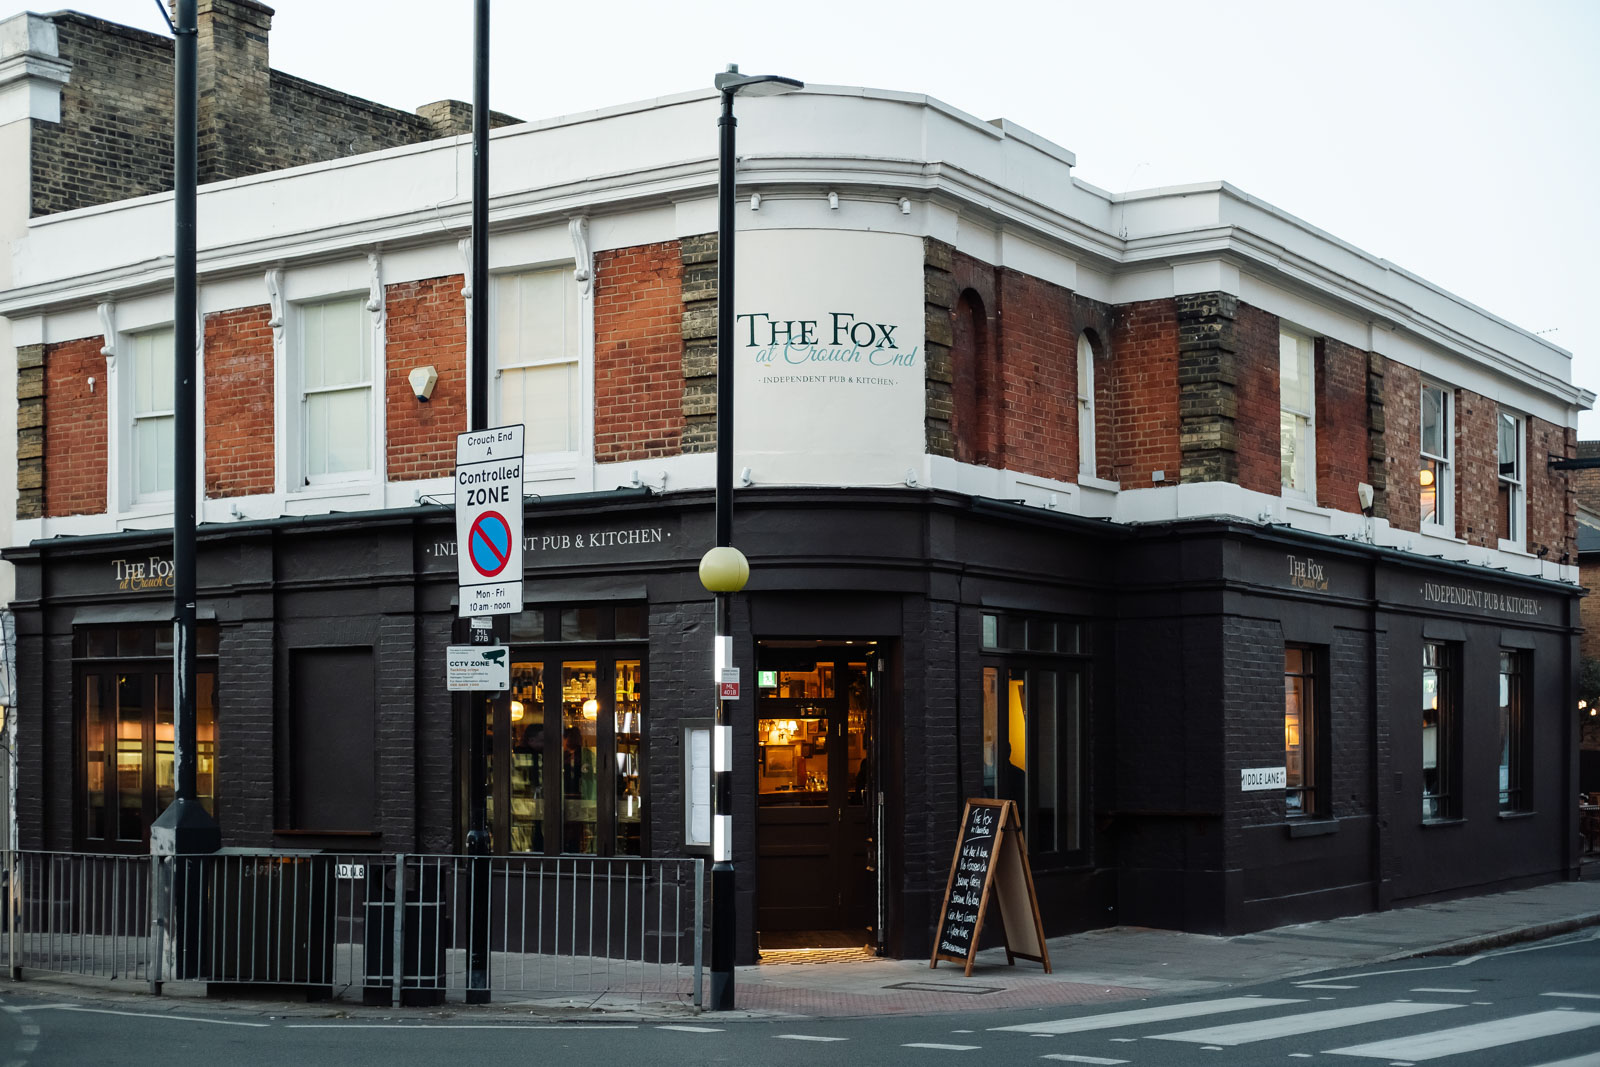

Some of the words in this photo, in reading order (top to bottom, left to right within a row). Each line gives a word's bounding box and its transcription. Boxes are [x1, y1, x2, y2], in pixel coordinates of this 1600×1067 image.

[755, 340, 778, 363] at
[783, 334, 862, 365] Crouch
[869, 337, 918, 367] End
[763, 375, 827, 384] INDEPENDENT
[829, 375, 846, 384] PUB
[848, 376, 854, 384] &
[856, 376, 894, 386] KITCHEN
[467, 434, 495, 446] Crouch
[497, 431, 513, 442] End
[486, 446, 492, 456] A
[459, 464, 520, 485] Controlled
[467, 485, 510, 506] ZONE
[542, 535, 571, 550] PUB
[574, 534, 584, 548] &
[588, 528, 663, 547] KITCHEN
[476, 589, 490, 599] Mon
[495, 588, 505, 597] Fri
[1424, 582, 1482, 608] INDEPENDENT
[1484, 592, 1499, 610] PUB
[1499, 594, 1505, 611] &
[1506, 596, 1538, 615] KITCHEN
[469, 602, 478, 612] 10
[493, 602, 511, 610] noon
[1264, 772, 1280, 785] LANE
